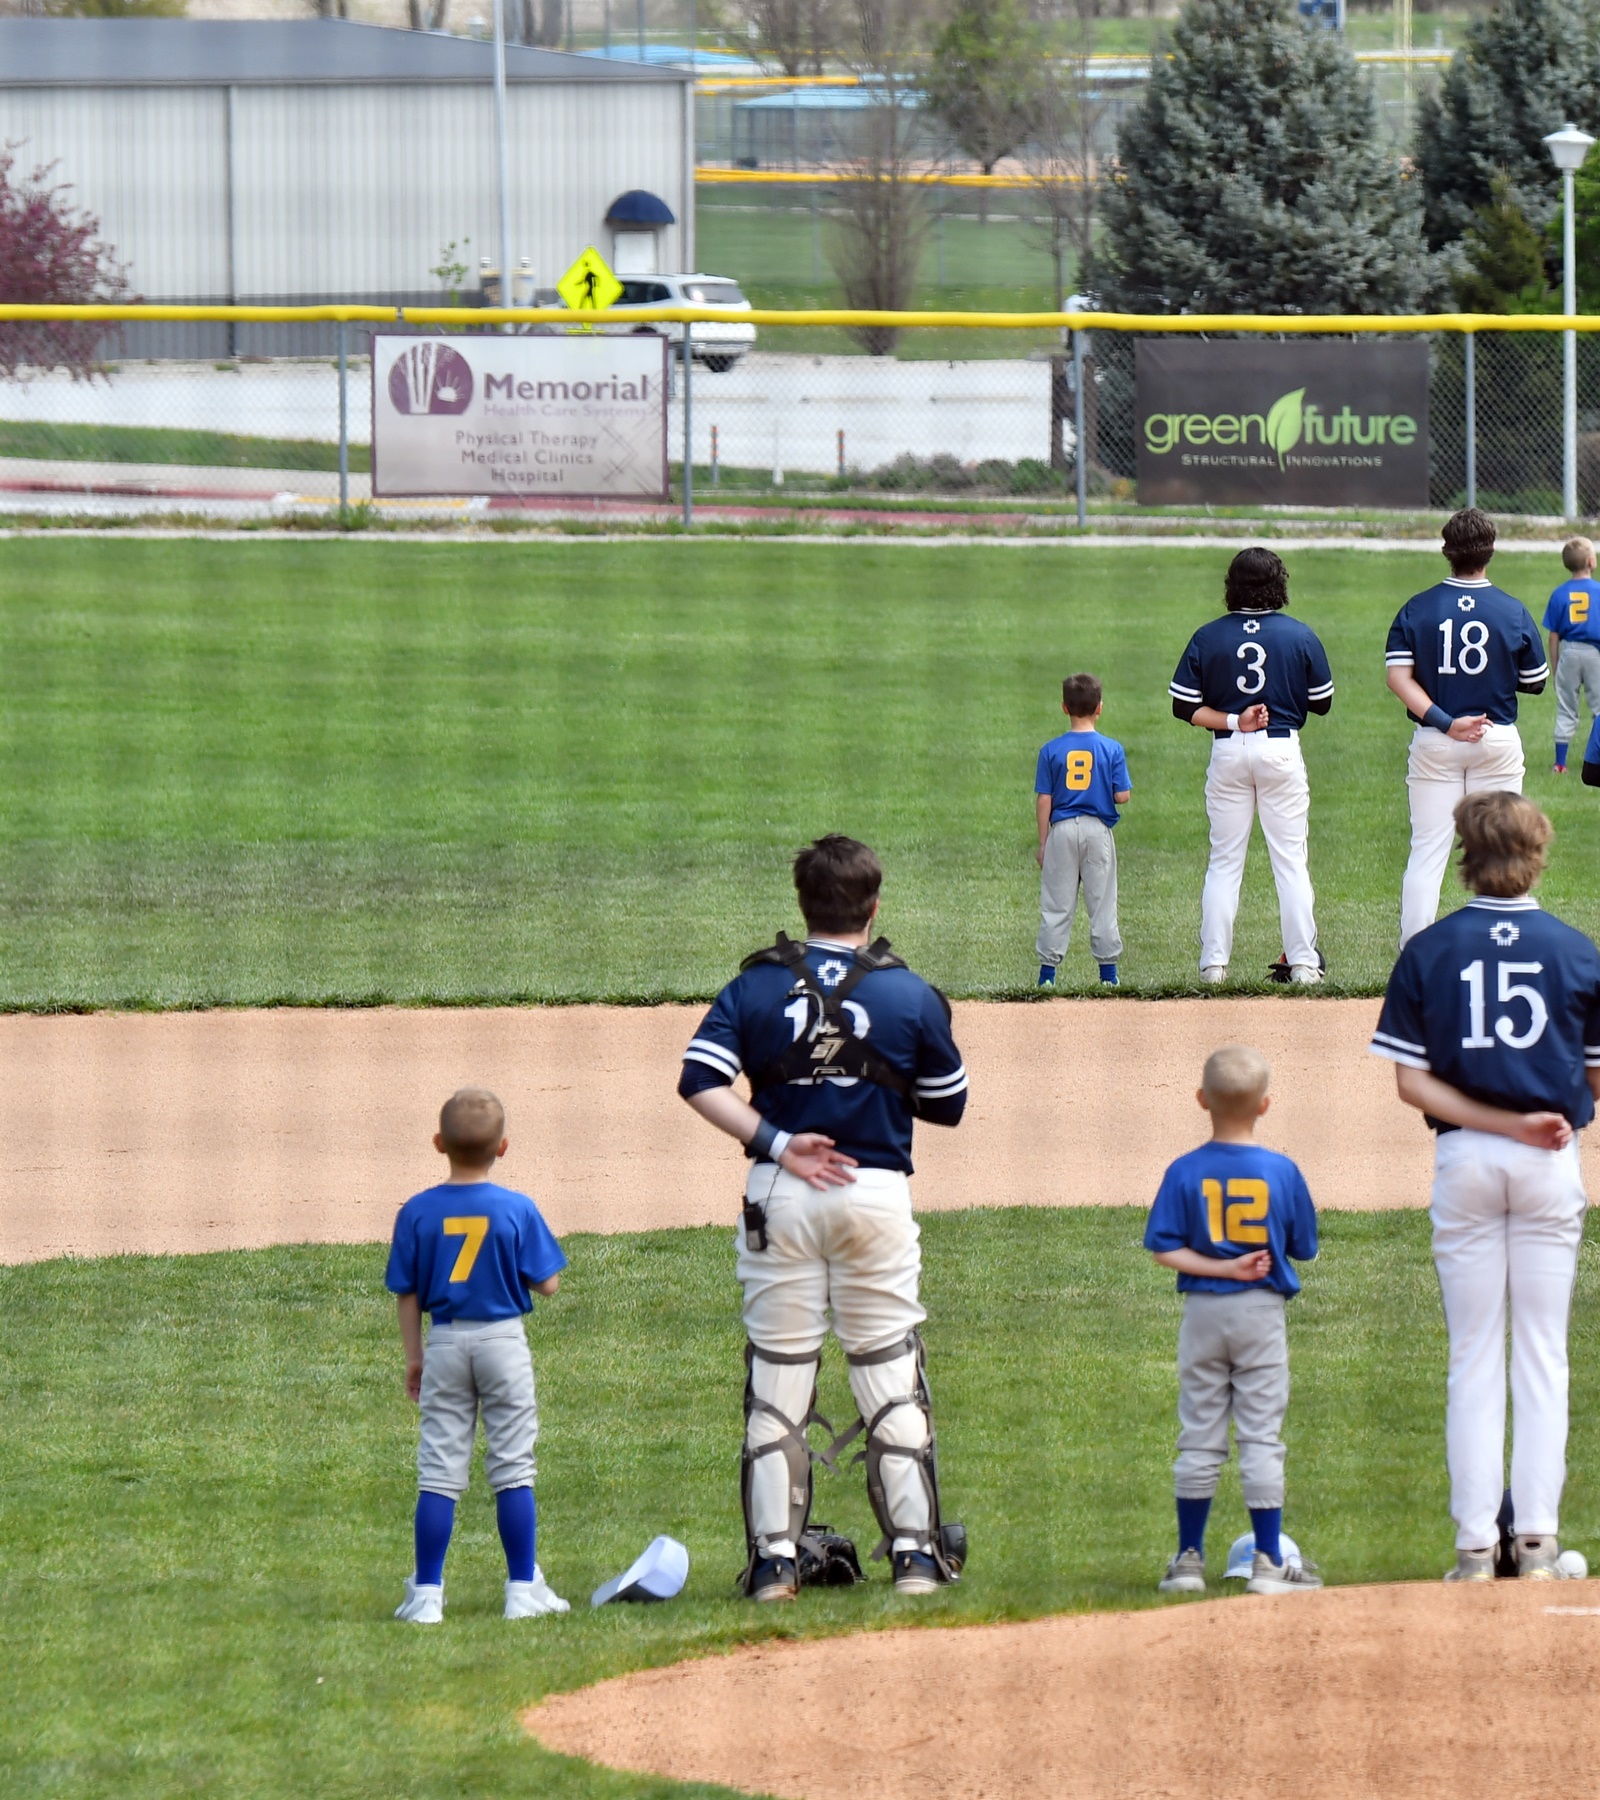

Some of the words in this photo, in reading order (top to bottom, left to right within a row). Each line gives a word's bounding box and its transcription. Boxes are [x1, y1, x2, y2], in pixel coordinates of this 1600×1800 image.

[484, 373, 648, 401] Memorial
[541, 405, 577, 417] Care
[455, 431, 523, 449] Physical
[530, 431, 597, 450] Therapy
[1144, 413, 1267, 454] green
[1302, 405, 1418, 445] future
[461, 450, 528, 465] Medical
[535, 450, 594, 465] Clinics
[1181, 454, 1276, 467] STRUCTURAL
[1286, 454, 1383, 467] INNOVATIONS
[491, 469, 564, 485] Hospital
[1569, 591, 1590, 623] 2
[1437, 618, 1490, 675] 18
[1236, 641, 1267, 695] 3
[1065, 750, 1094, 791] 8
[1459, 959, 1549, 1049] 15
[1201, 1178, 1270, 1244] 12
[443, 1216, 490, 1283] 7
